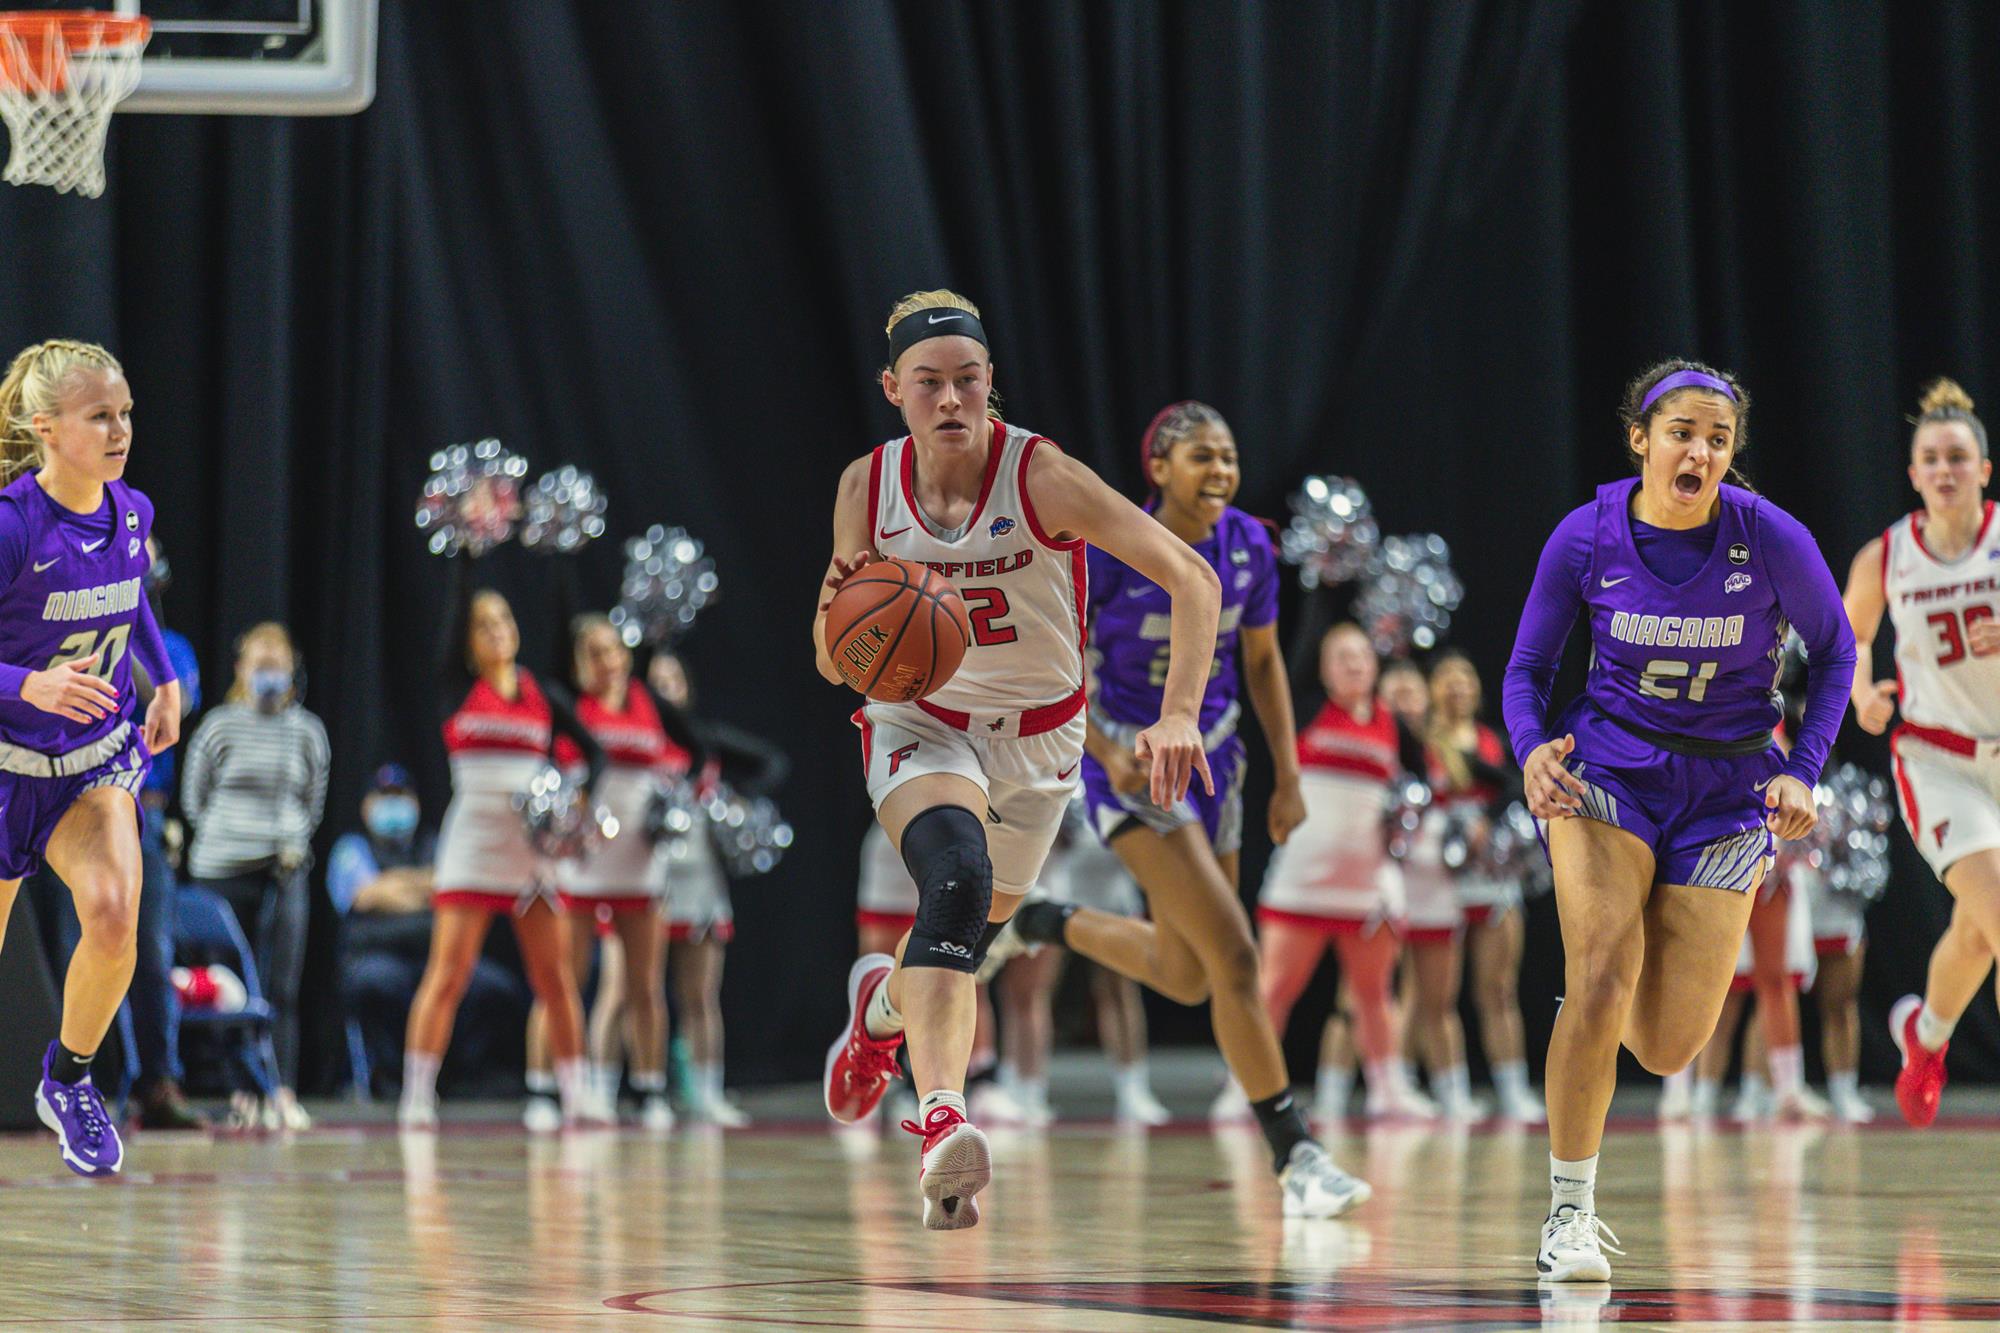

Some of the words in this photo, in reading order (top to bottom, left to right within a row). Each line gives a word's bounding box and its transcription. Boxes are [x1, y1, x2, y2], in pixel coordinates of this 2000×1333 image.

[914, 549, 1033, 578] RFIELD
[1730, 549, 1748, 559] BLM
[42, 576, 141, 621] NIAGARA
[1901, 577, 1999, 606] FAIRFIEL
[960, 587, 1018, 648] 2
[1610, 611, 1745, 648] NIAGARA
[47, 623, 131, 684] 20
[843, 623, 889, 673] ROCK
[1639, 660, 1718, 702] 21
[888, 741, 920, 777] F
